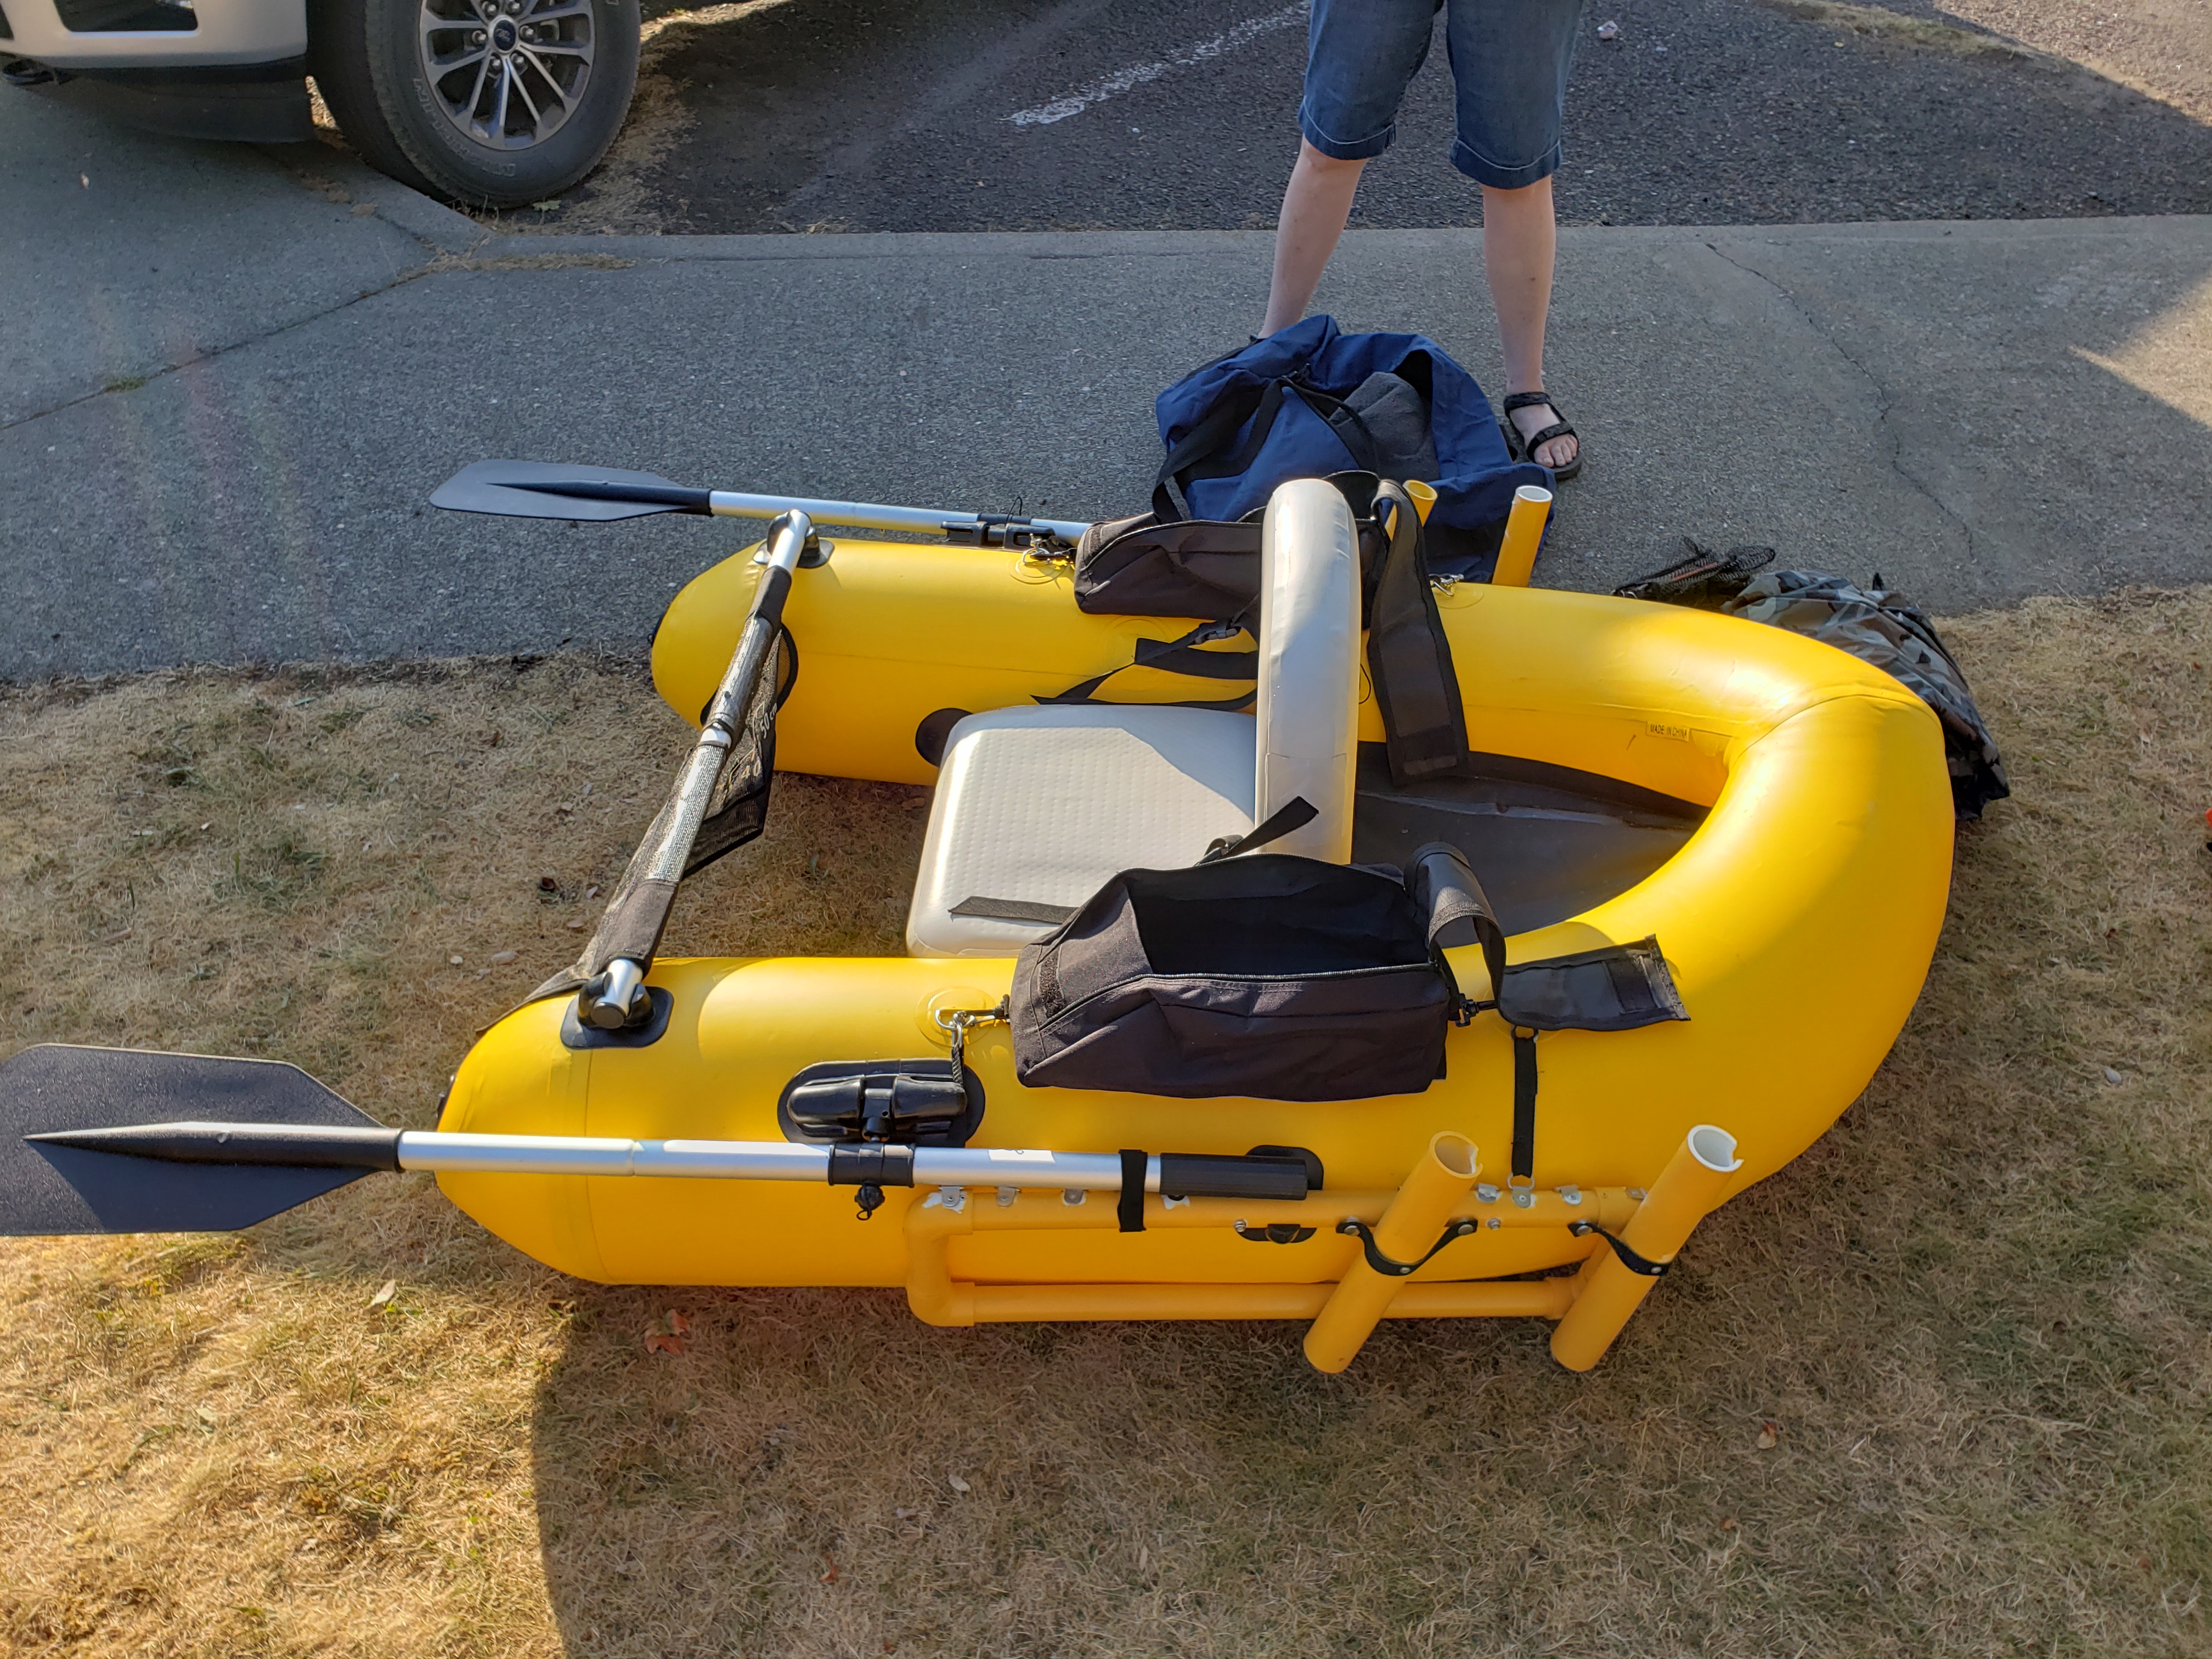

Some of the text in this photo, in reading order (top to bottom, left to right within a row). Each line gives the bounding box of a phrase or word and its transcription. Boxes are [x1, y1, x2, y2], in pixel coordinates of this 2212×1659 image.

[760, 712, 770, 739] 50
[1650, 724, 1687, 738] MADE IN CHINA
[741, 759, 761, 780] 40
